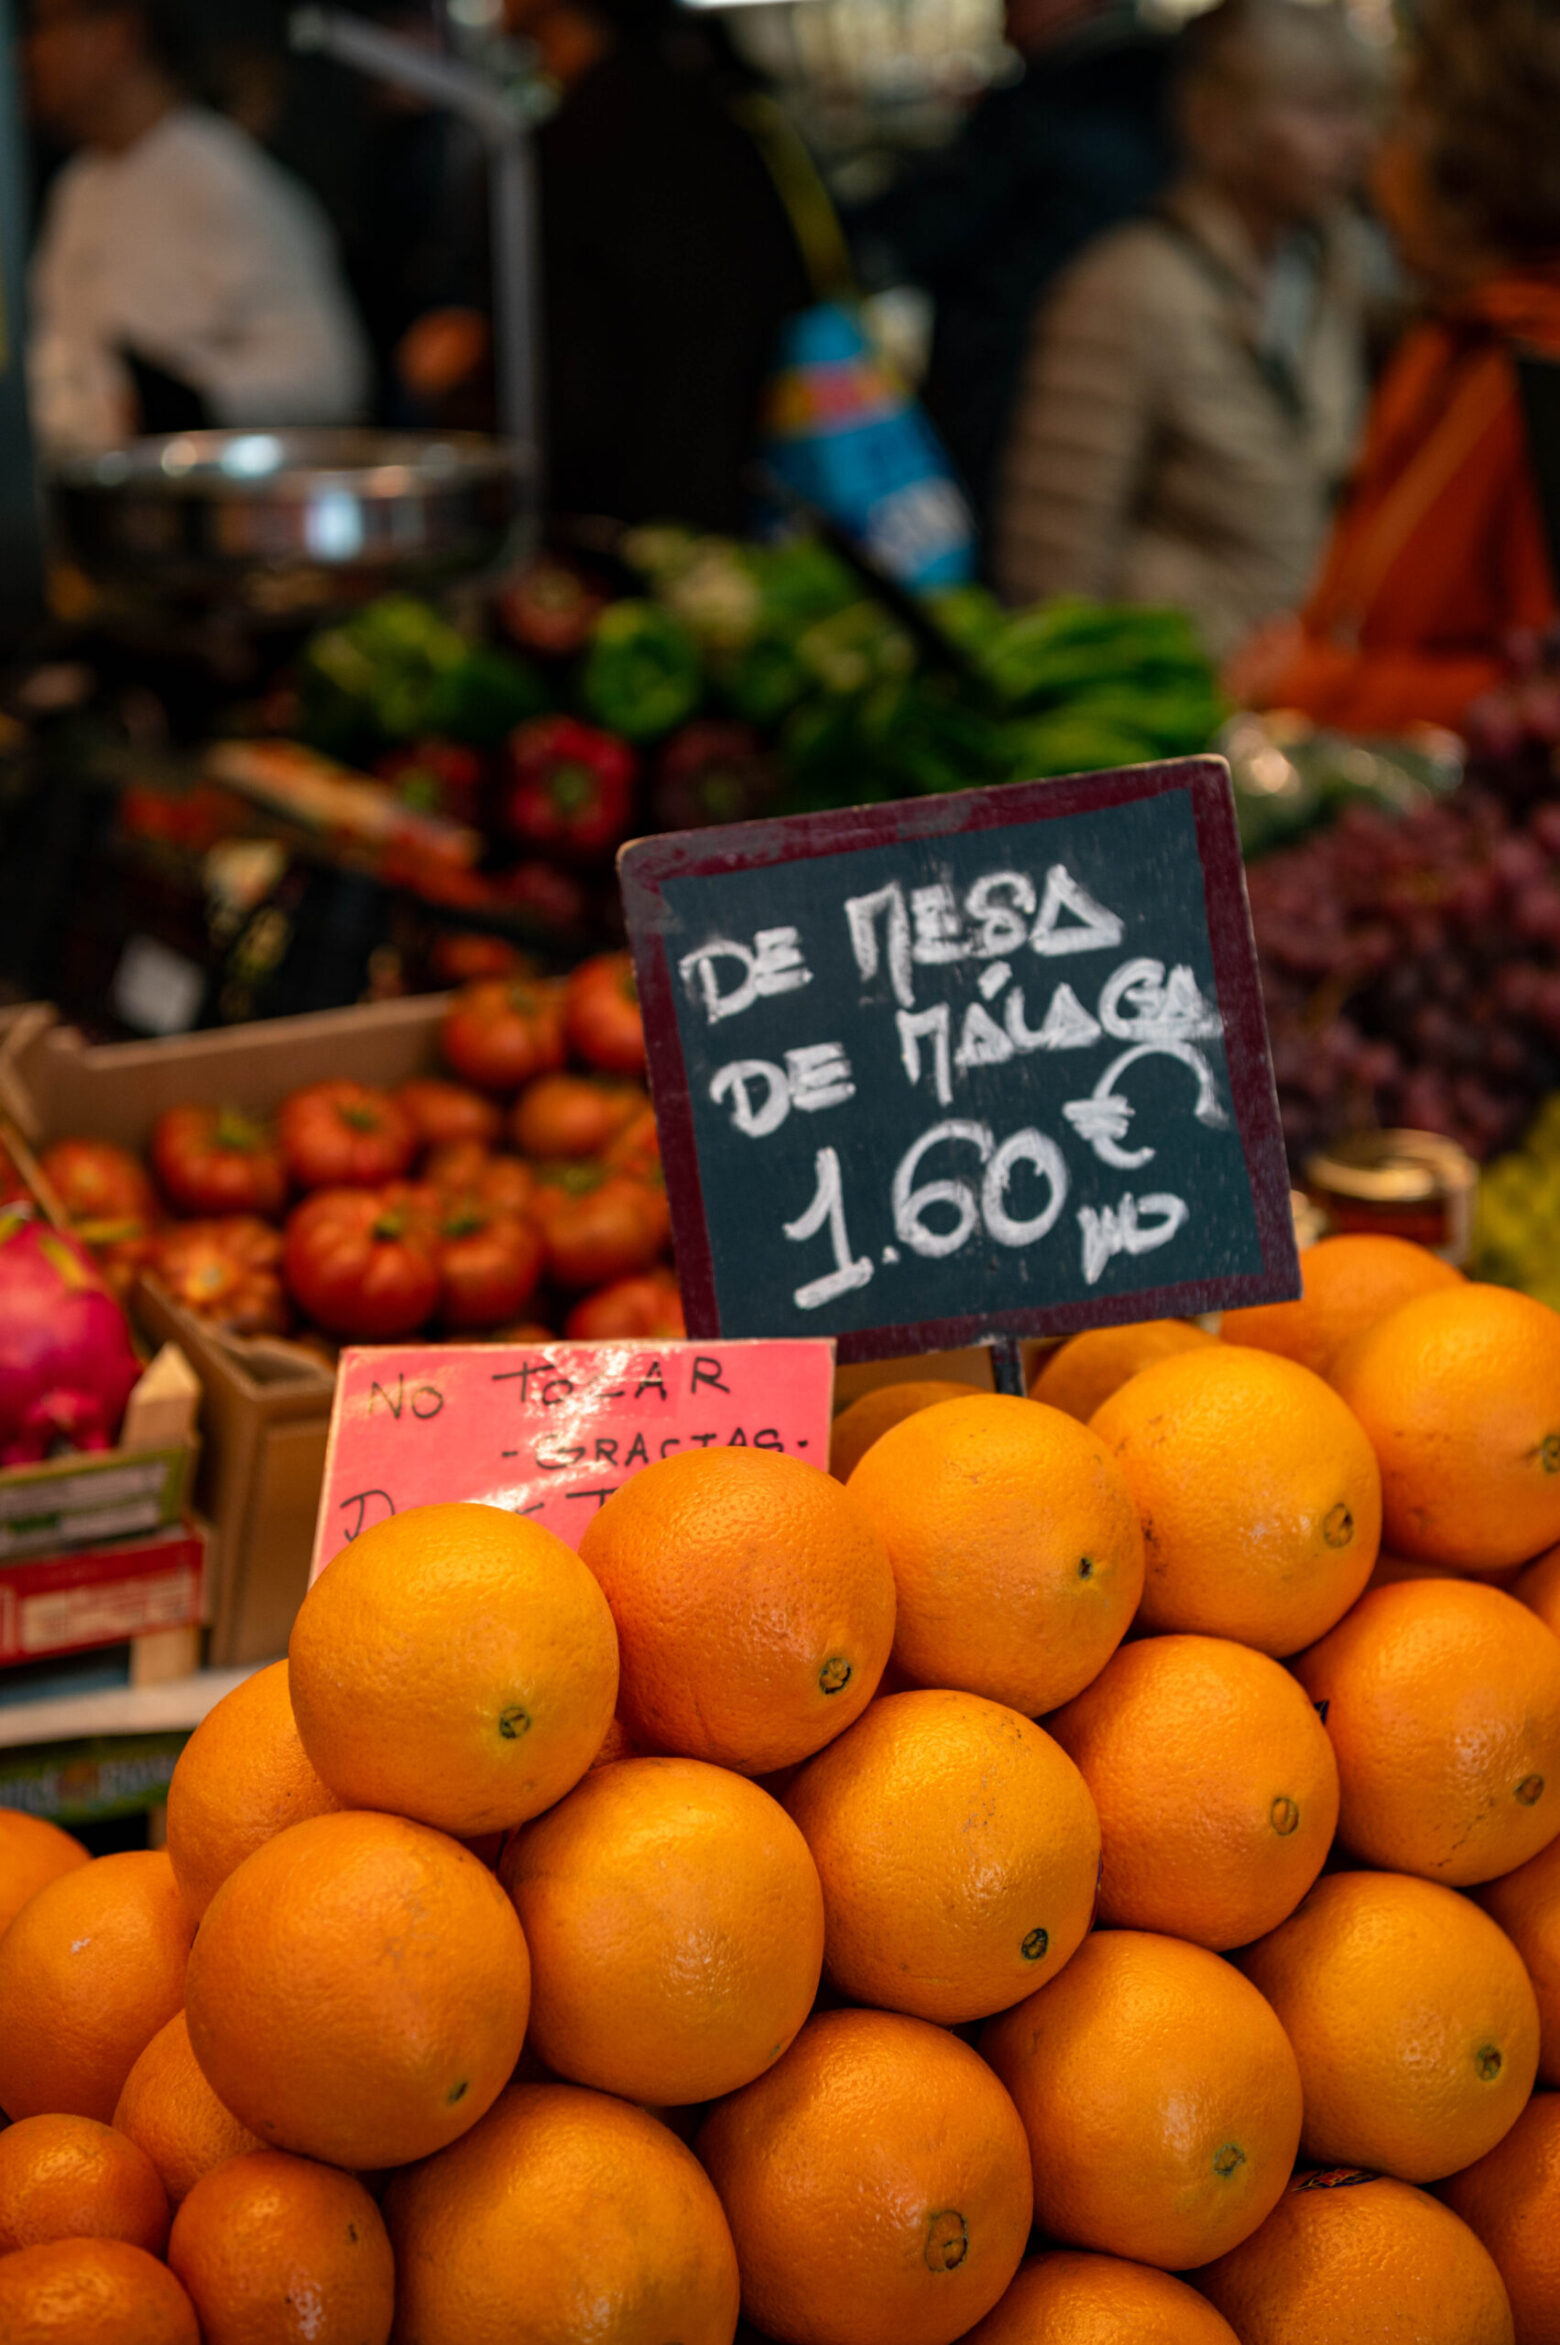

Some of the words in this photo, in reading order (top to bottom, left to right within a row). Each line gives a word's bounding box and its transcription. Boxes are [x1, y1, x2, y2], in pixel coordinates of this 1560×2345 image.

[679, 926, 814, 1025] DE
[844, 863, 1126, 1008] MESA
[709, 1041, 857, 1138] DE
[783, 1119, 1069, 1310] 1.60
[368, 1372, 445, 1420] NO
